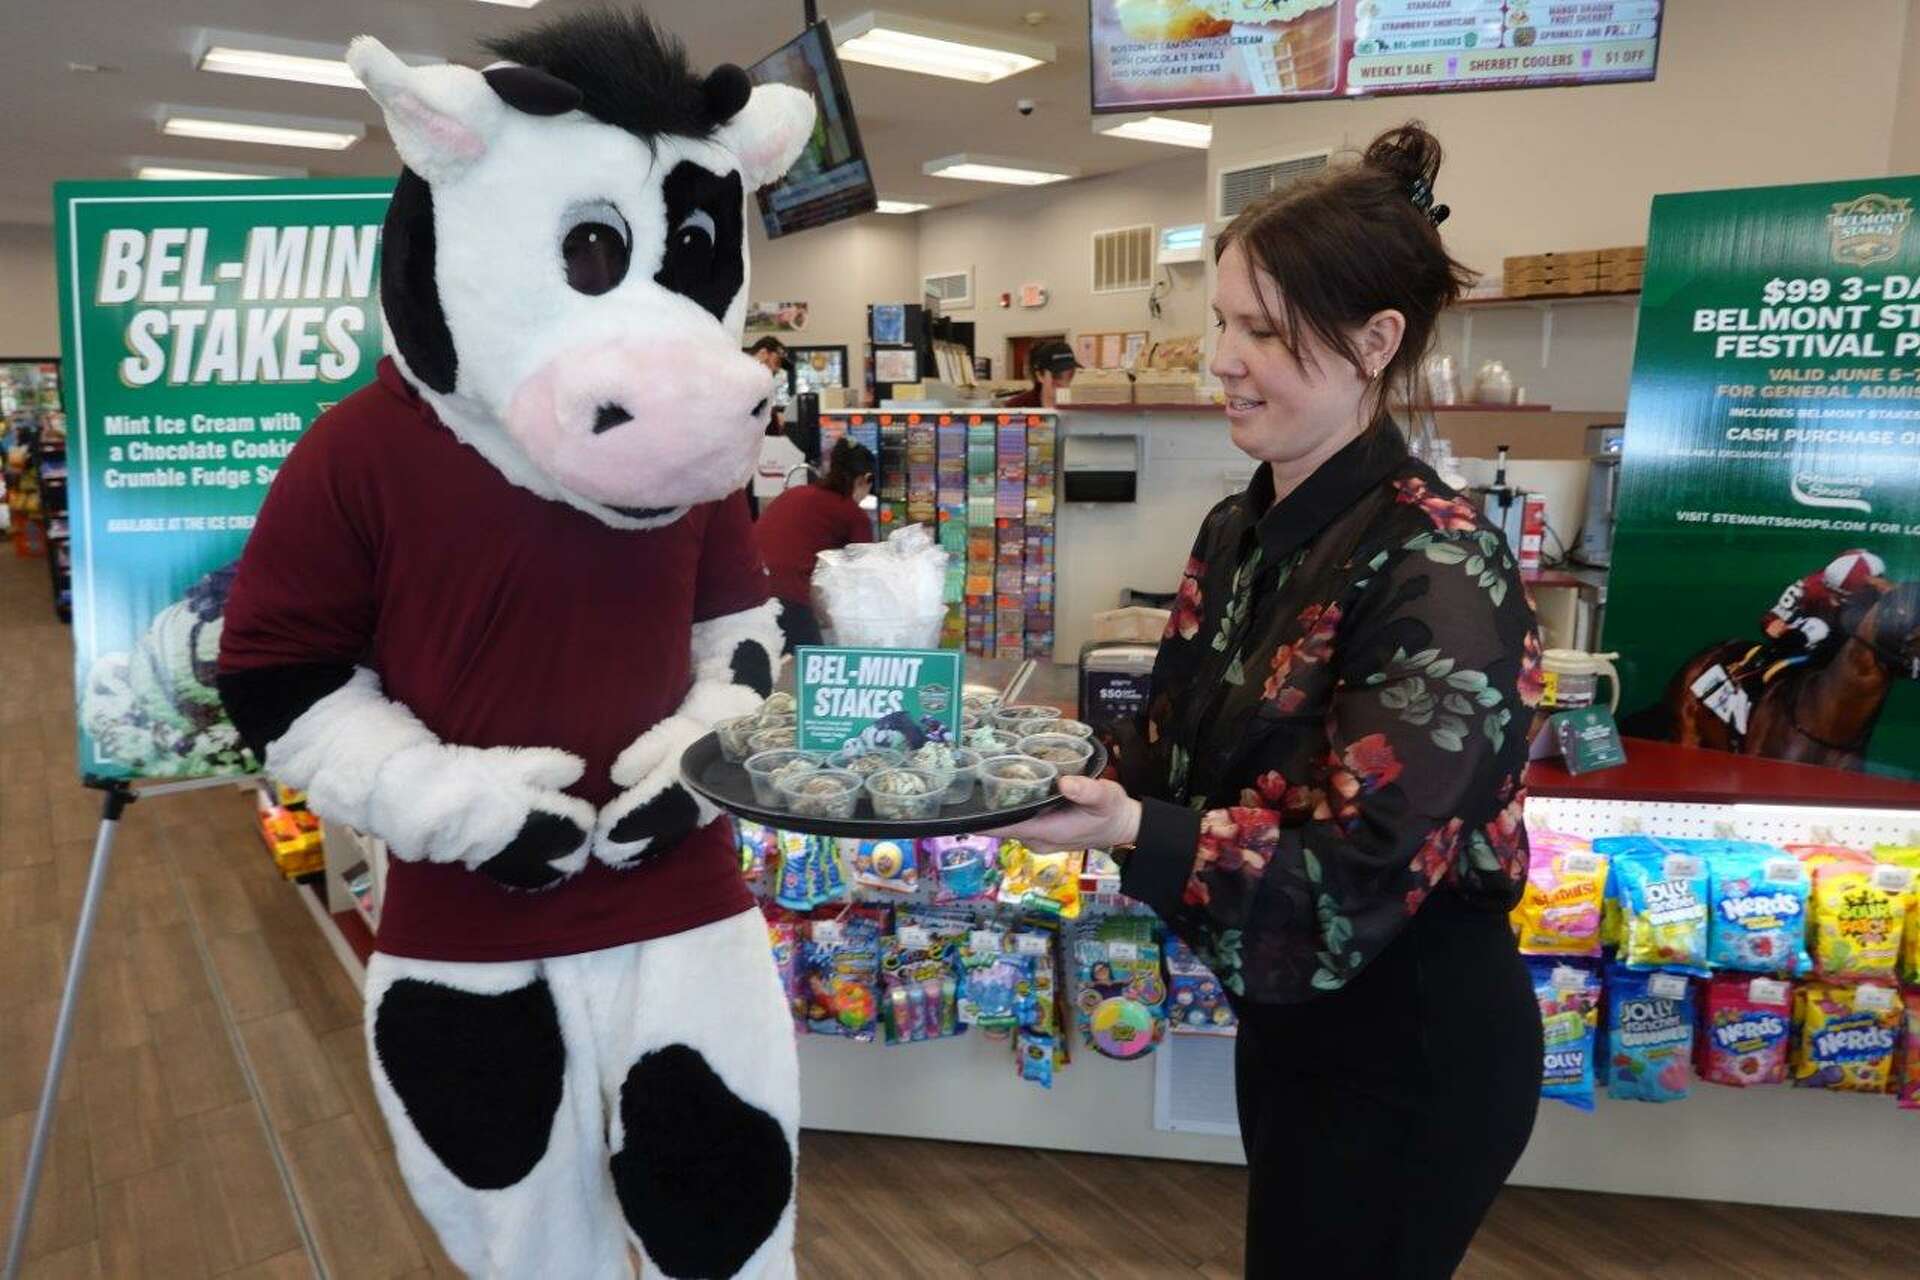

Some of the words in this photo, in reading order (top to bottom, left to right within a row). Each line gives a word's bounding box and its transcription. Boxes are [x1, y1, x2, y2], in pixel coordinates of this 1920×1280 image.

[1231, 36, 1263, 46] CREAM
[1360, 65, 1402, 78] WEEKLY
[1406, 63, 1433, 75] SALE
[1469, 58, 1519, 72] SHERBET
[1522, 54, 1573, 68] COOLERS
[1605, 51, 1619, 64] $1
[1622, 50, 1646, 63] OFF
[97, 224, 384, 305] BEL-MIN
[1763, 277, 1831, 306] $99
[1692, 304, 1870, 332] BELMONT
[120, 306, 366, 386] STAKES
[1715, 332, 1885, 359] FESTIVAL
[1894, 331, 1920, 357] P
[1768, 367, 1825, 382] VALID
[1828, 367, 1884, 382] JUNE
[1716, 384, 1756, 399] FOR
[1760, 384, 1852, 400] GENERAL
[103, 415, 151, 435] Mint
[154, 414, 187, 434] Ice
[190, 413, 255, 433] Cream
[259, 412, 302, 432] with
[1728, 407, 1795, 419] INCLUDES
[1796, 408, 1865, 420] BELMONT
[1725, 427, 1779, 442] CASH
[1783, 428, 1895, 445] PURCHASE
[1899, 431, 1920, 446] O
[109, 445, 123, 462] a
[127, 440, 227, 462] Chocolate
[104, 467, 187, 488] Crumble
[190, 466, 251, 490] Fudge
[1676, 510, 1710, 523] VISIT
[1711, 512, 1868, 532] STEWARTSSHOPS.COM
[1870, 521, 1901, 534] FOR
[804, 654, 923, 688] BEL-MINT
[813, 686, 904, 719] STAKES
[1621, 1000, 1675, 1023] JOLLY
